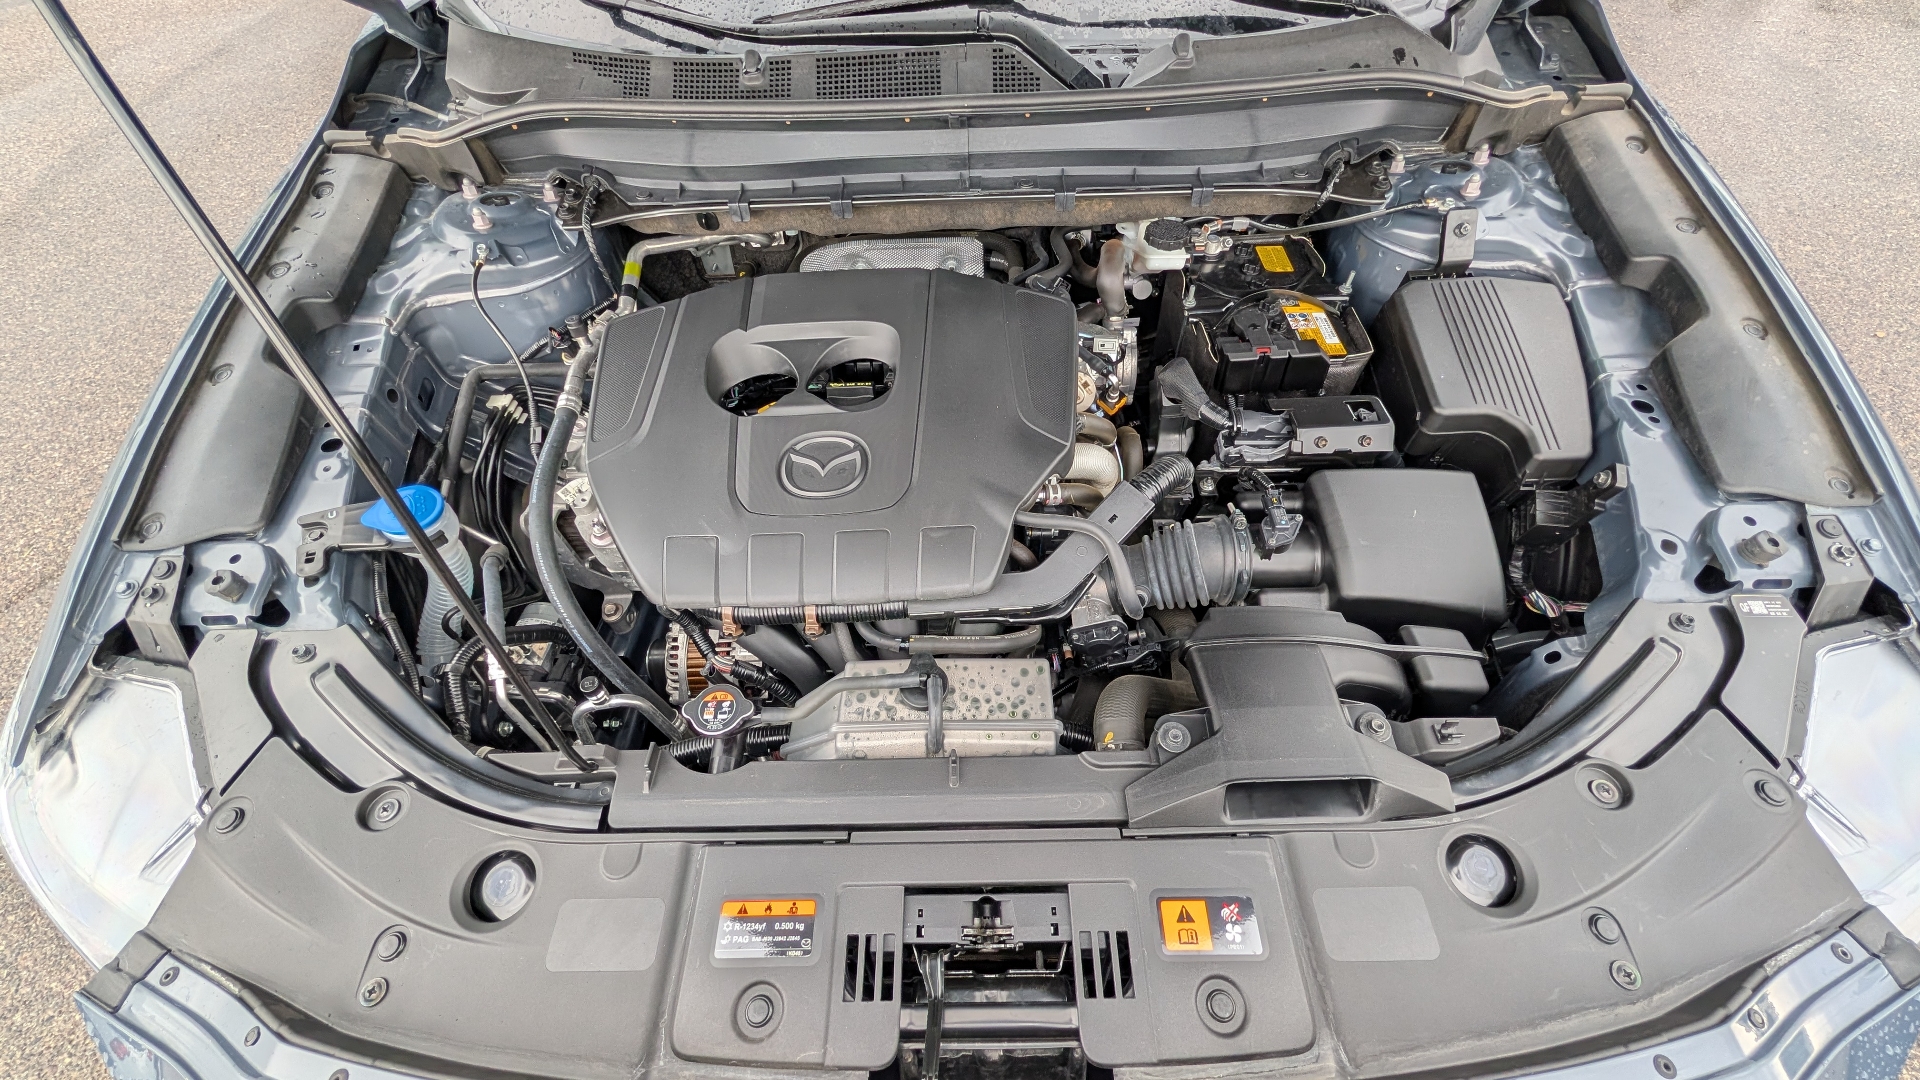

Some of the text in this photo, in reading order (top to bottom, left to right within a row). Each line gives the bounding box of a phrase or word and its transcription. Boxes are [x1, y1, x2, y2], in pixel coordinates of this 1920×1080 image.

[733, 921, 805, 931] R-1234yf 0.500 kg
[732, 935, 749, 943] PAG
